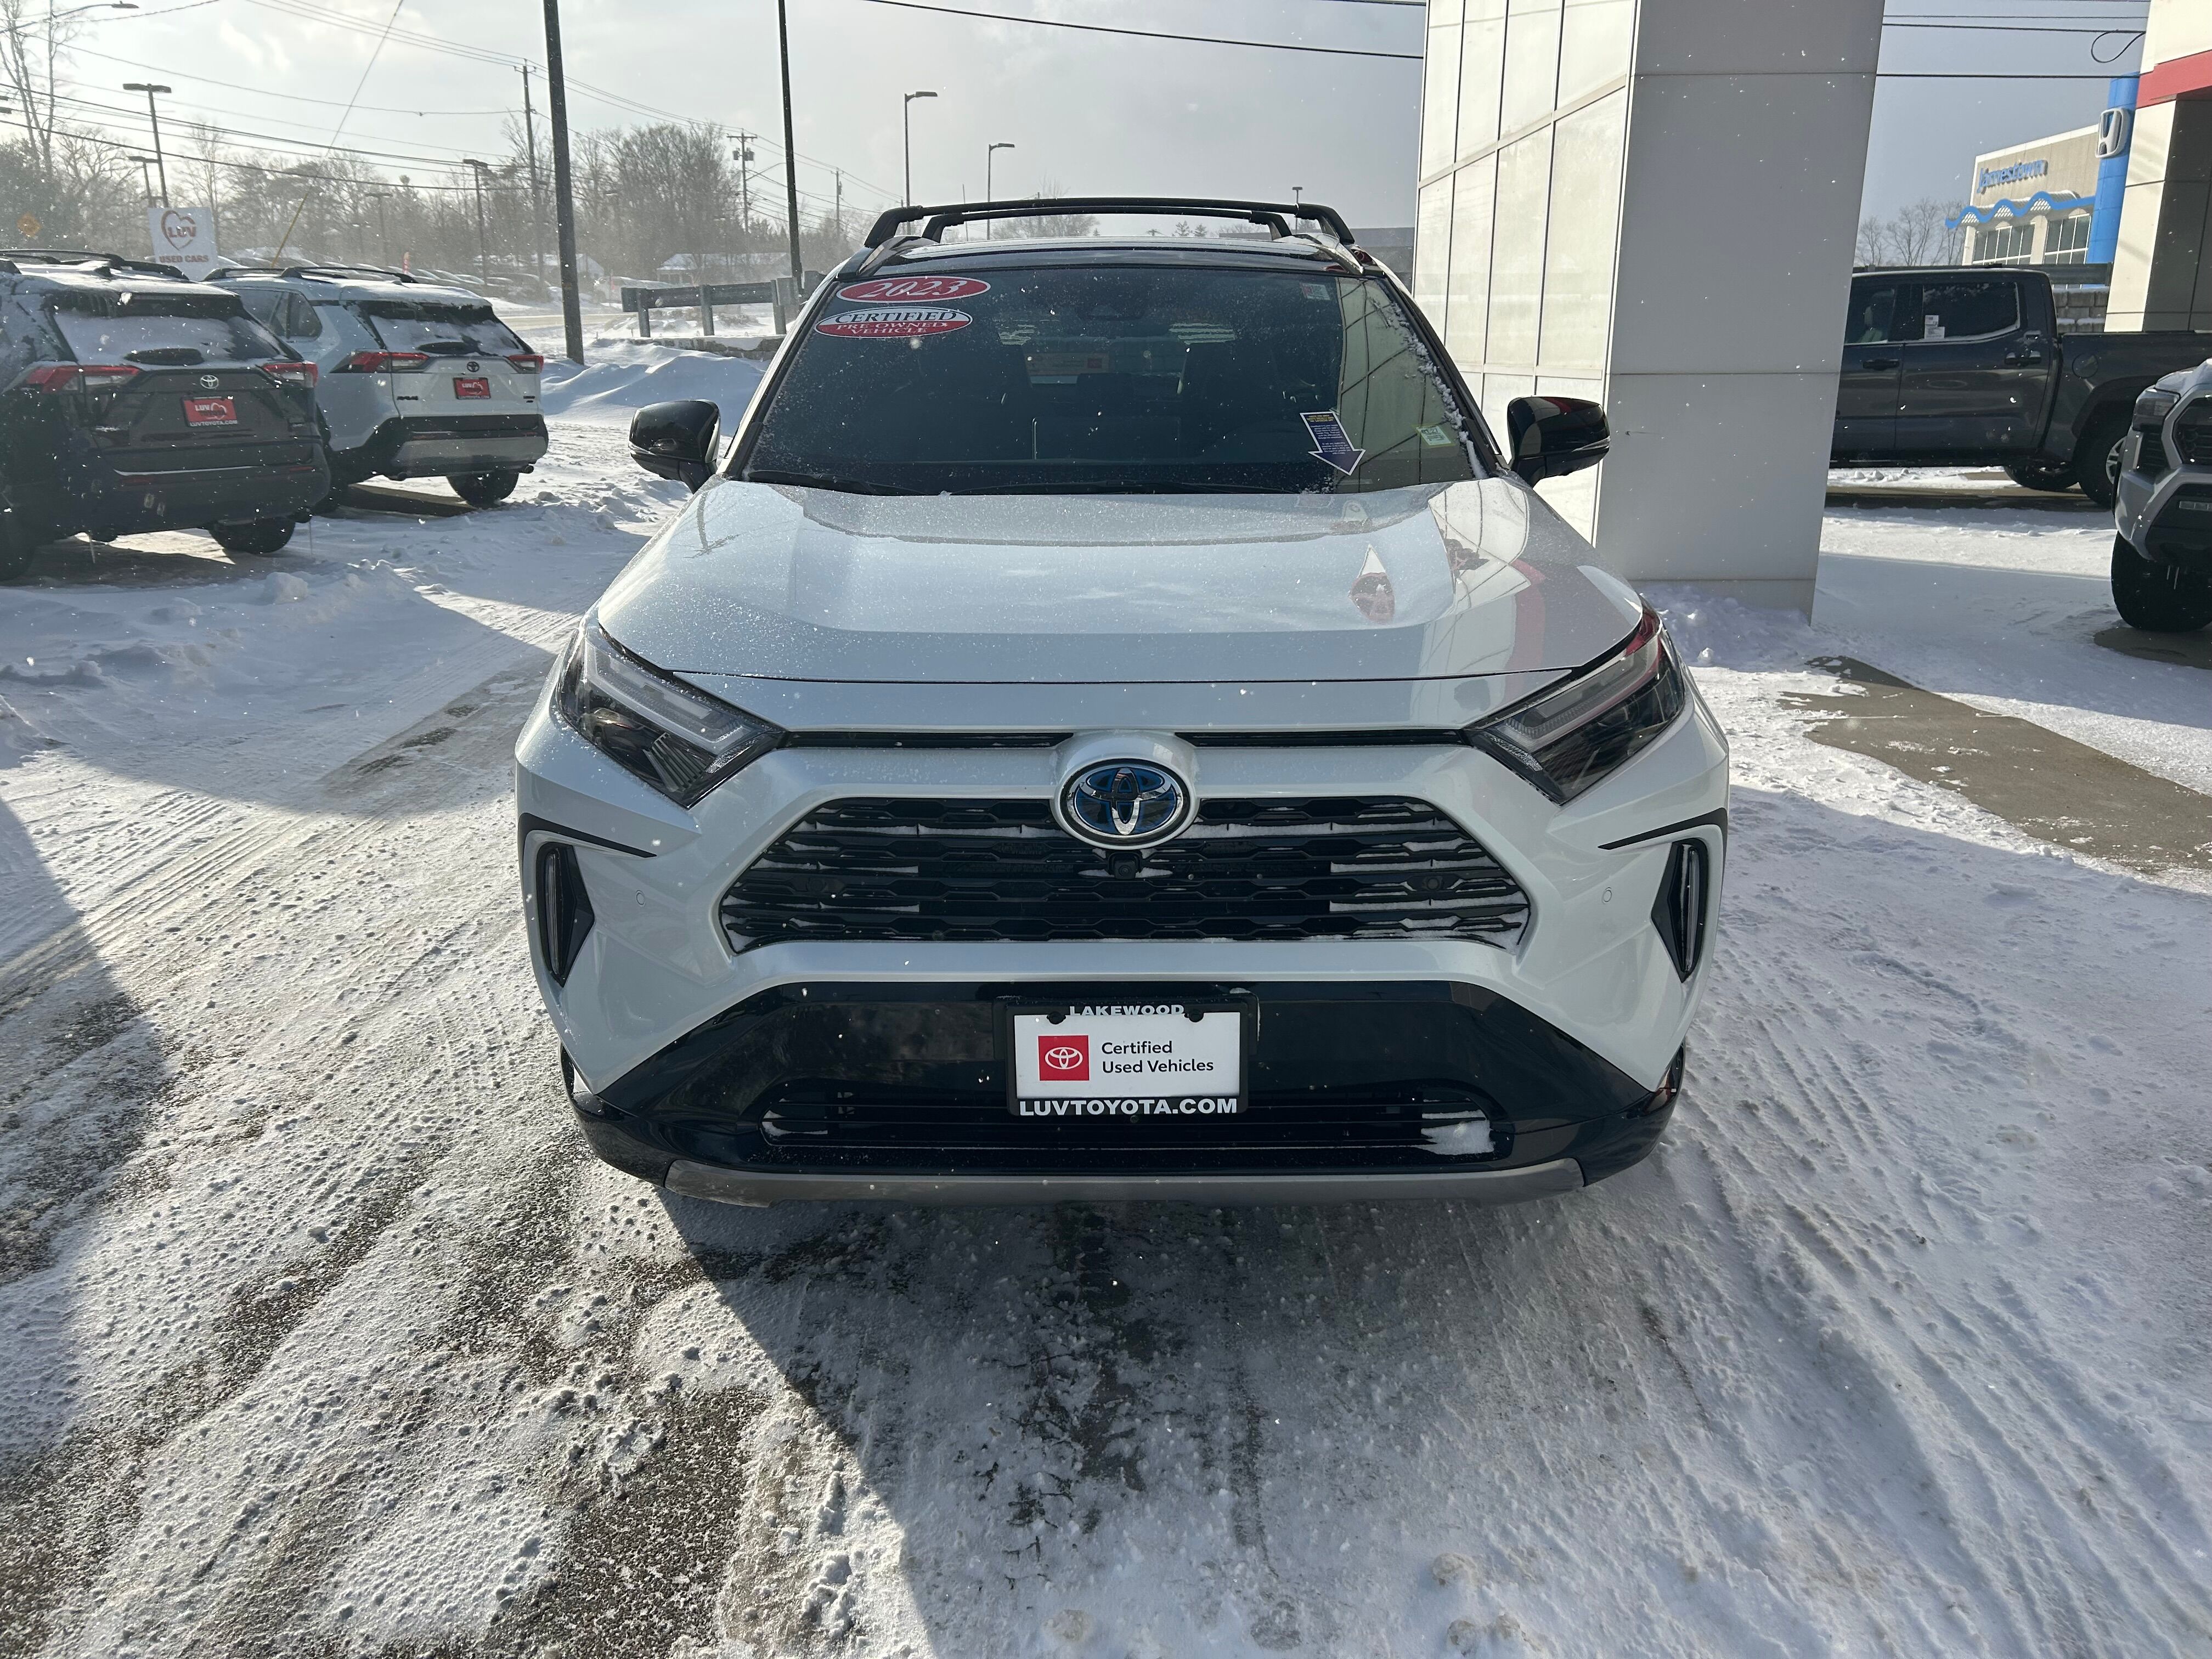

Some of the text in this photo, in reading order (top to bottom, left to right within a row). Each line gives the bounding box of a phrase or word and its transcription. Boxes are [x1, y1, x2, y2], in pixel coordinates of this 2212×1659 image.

[1977, 160, 2046, 194] Jamestown
[168, 227, 196, 238] LUV
[159, 255, 183, 263] USED
[857, 280, 967, 298] 2023
[835, 312, 956, 324] CERTIFIED
[1069, 1005, 1184, 1017] LAKEWOOD
[1101, 1041, 1172, 1054] Certified
[1102, 1059, 1214, 1073] Used Vehicles
[1019, 1098, 1237, 1116] LUVTOYOTA.COM
